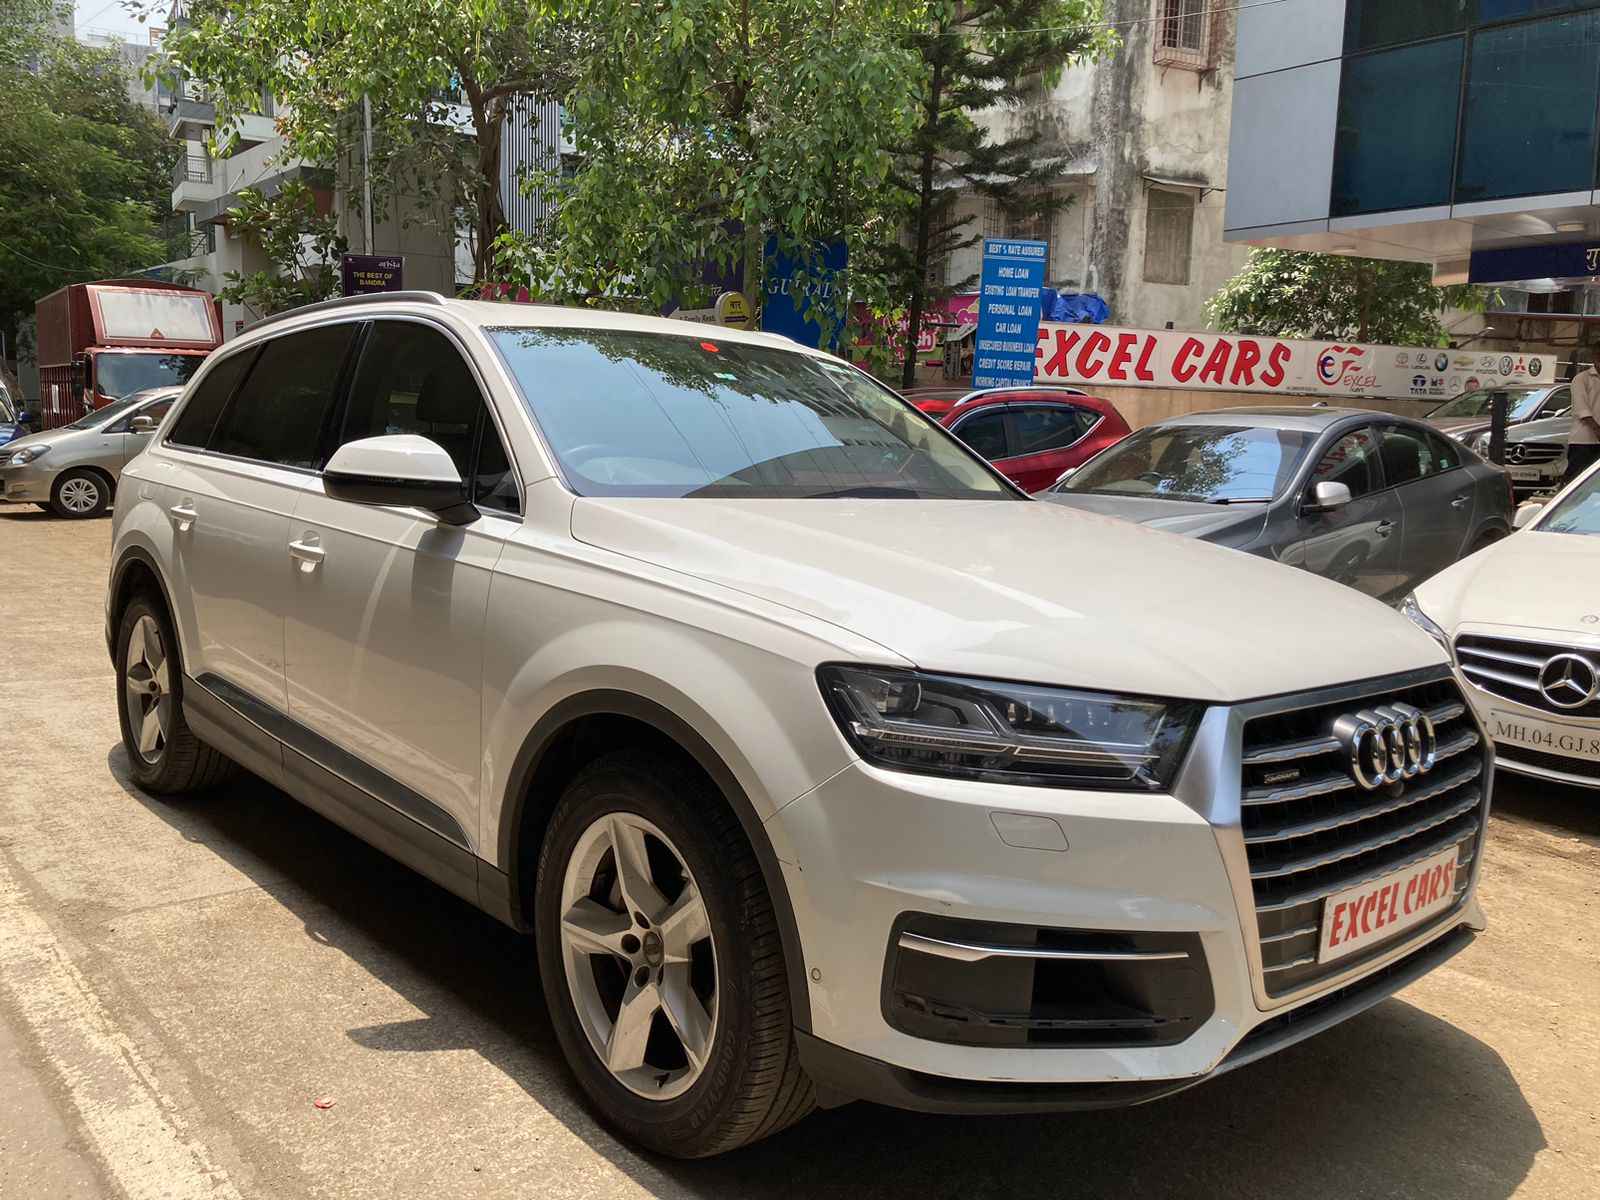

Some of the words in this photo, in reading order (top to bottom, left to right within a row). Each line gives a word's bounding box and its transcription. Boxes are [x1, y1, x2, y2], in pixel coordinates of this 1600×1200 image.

[988, 244, 1001, 253] BEST
[1008, 245, 1021, 255] RATE
[1022, 246, 1044, 256] ASSURED
[998, 266, 1014, 278] HOME
[1015, 268, 1029, 279] LOAN
[985, 284, 1004, 296] EXISTING
[1005, 286, 1017, 297] LOAN
[1018, 287, 1039, 298] TRANSFER
[988, 303, 1015, 316] PERSONAL
[1018, 305, 1032, 317] LOAN
[995, 322, 1006, 333] CAR
[1007, 323, 1021, 334] LOAN
[979, 358, 996, 369] CREDIT
[997, 360, 1013, 370] SCORE
[1014, 361, 1031, 371] REPAIR
[1171, 336, 1292, 388] CARS
[1329, 882, 1400, 948] EXCEL
[1402, 857, 1456, 916] CARS
